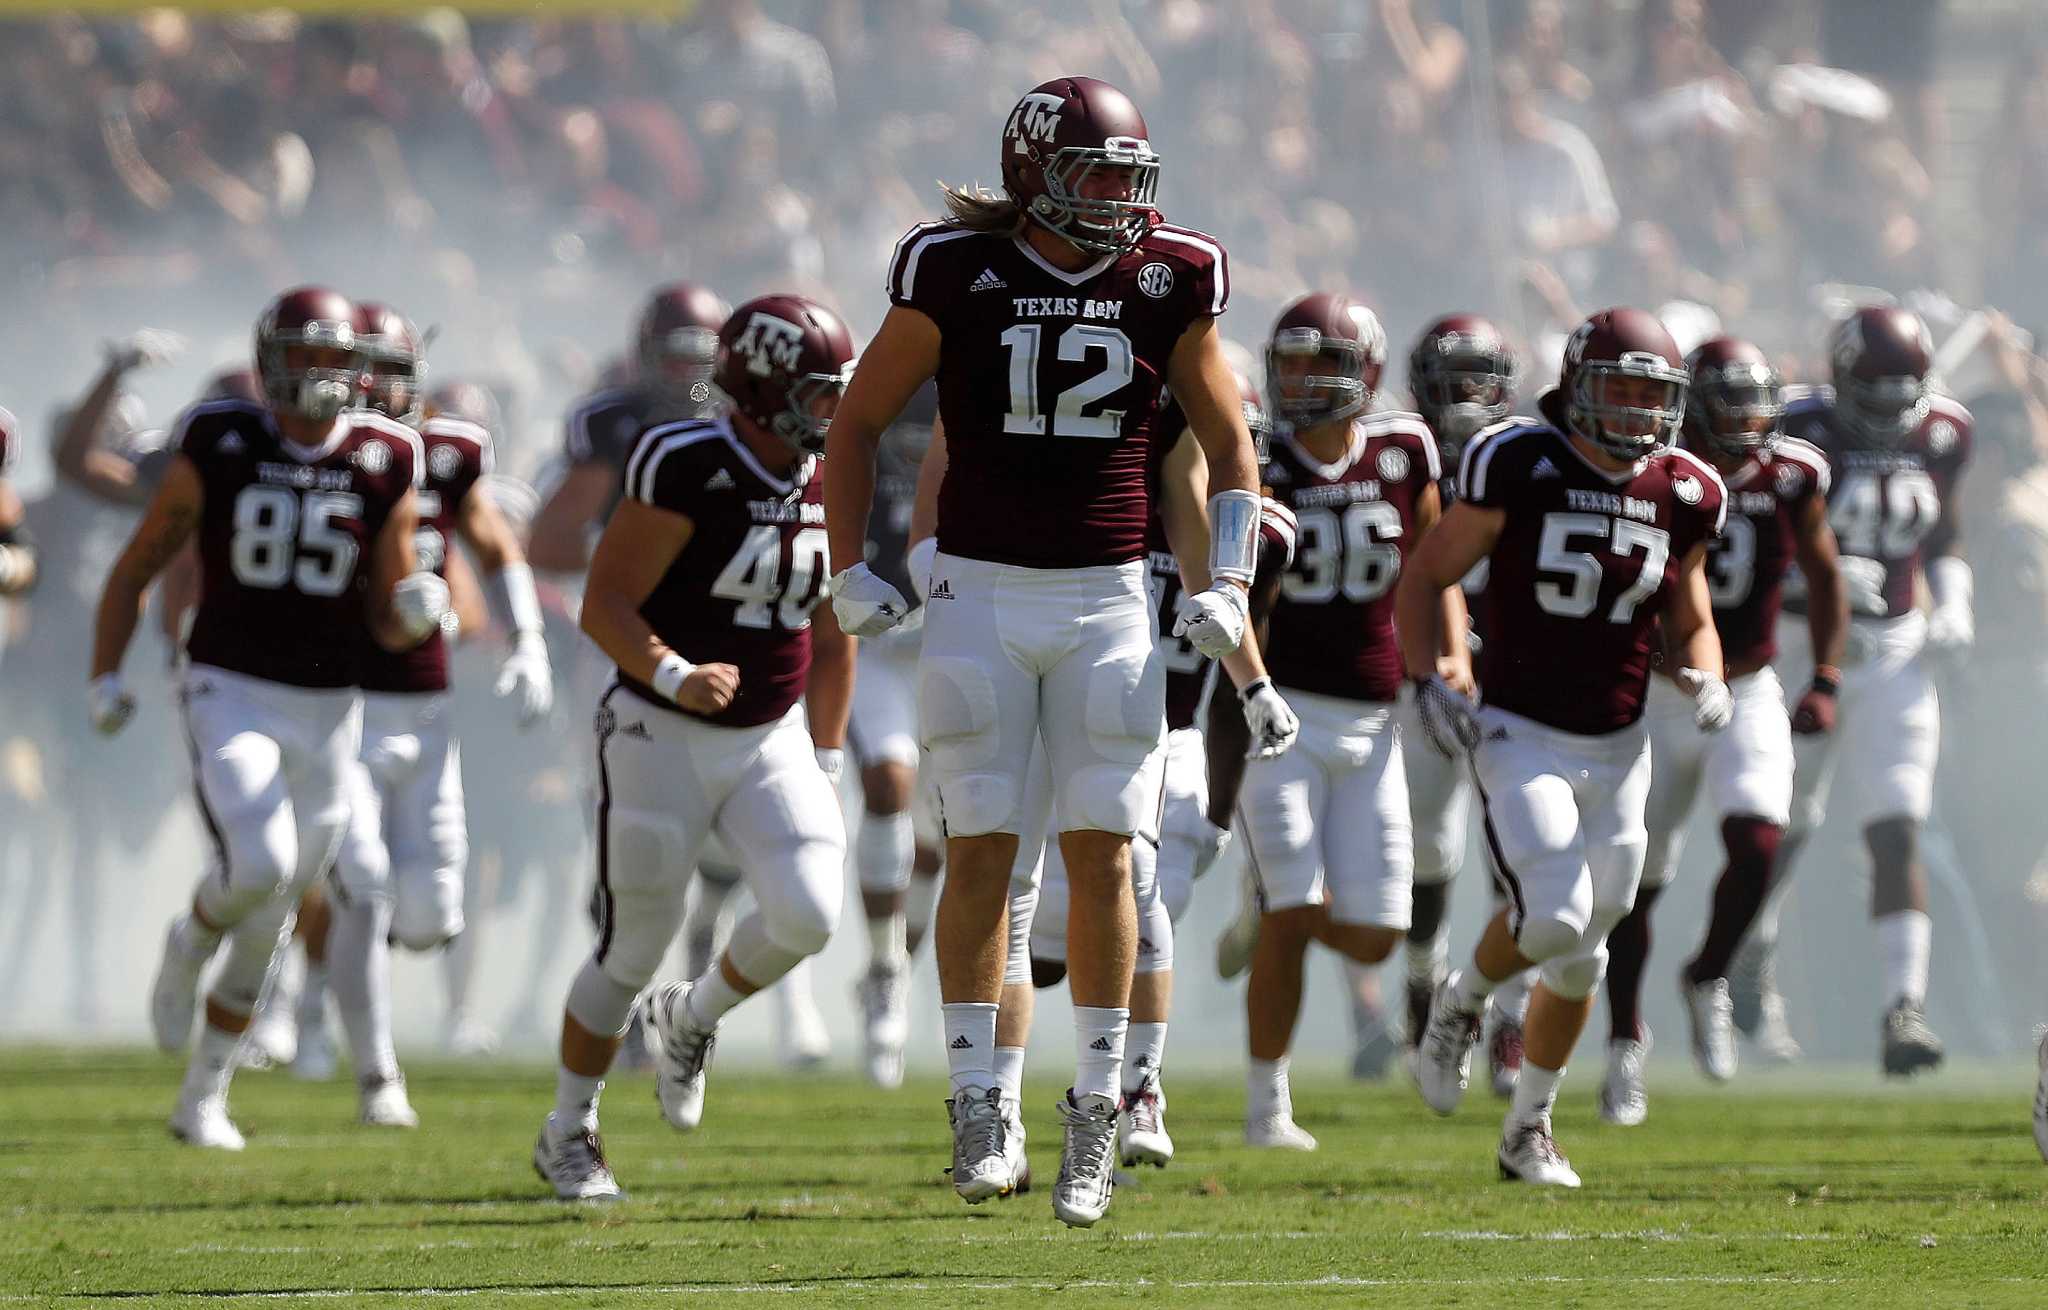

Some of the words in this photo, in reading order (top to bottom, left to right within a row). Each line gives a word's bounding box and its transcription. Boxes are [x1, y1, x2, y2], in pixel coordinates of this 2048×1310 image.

[969, 280, 1008, 293] adidas
[1013, 298, 1078, 317] TEXAS
[1083, 300, 1123, 319] A&M
[1141, 265, 1170, 296] SEC
[1001, 324, 1134, 438] 12
[231, 484, 364, 597] 85
[710, 525, 832, 630] 40
[1281, 501, 1403, 604] 36
[1533, 513, 1670, 624] 57
